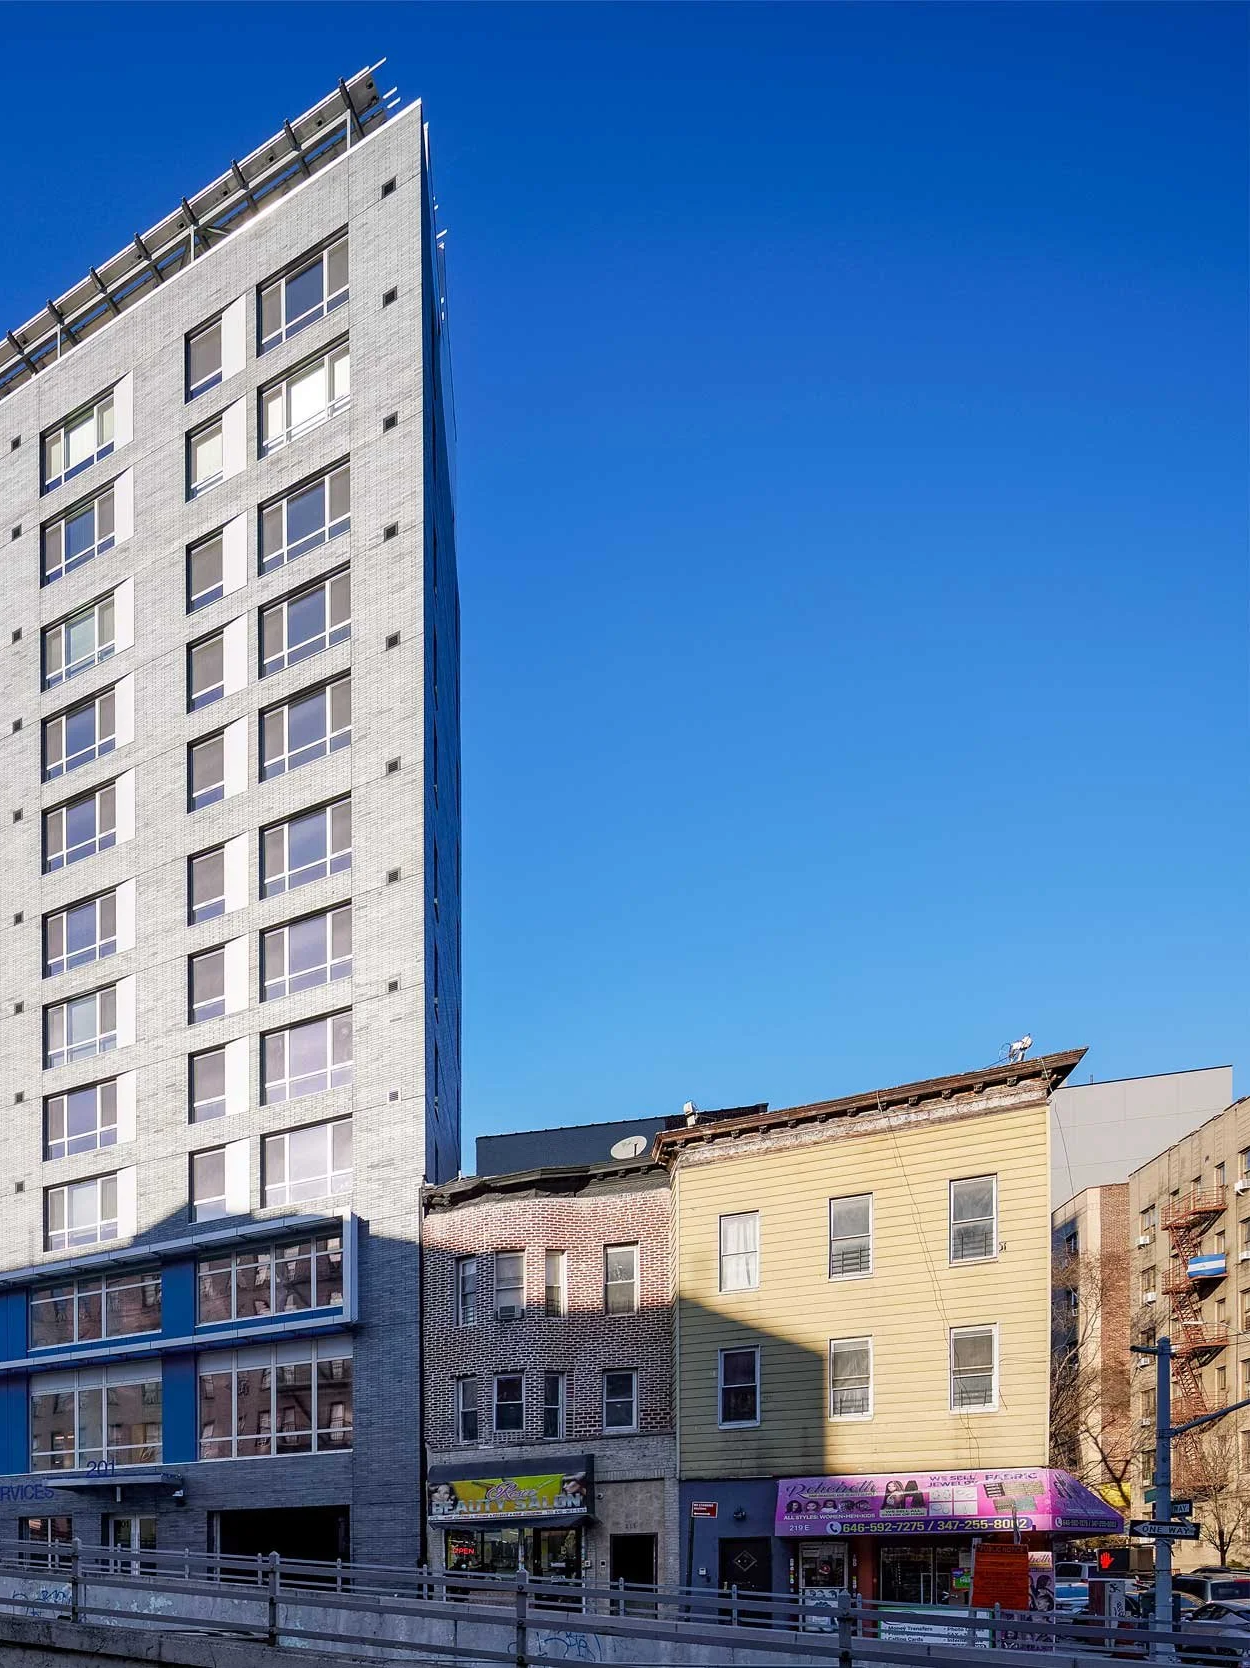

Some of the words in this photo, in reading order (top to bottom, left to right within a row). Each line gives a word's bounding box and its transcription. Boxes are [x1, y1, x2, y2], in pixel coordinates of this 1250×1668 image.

[86, 1457, 116, 1478] 201
[984, 1472, 1038, 1481] FABRIC
[431, 1499, 509, 1515] BEAUTY
[514, 1493, 581, 1511] SALON
[789, 1524, 804, 1532] 219
[843, 1520, 925, 1533] 646-592-7275
[1142, 1525, 1163, 1533] ONE
[1168, 1526, 1190, 1534] WAY
[452, 1547, 475, 1555] OPEN
